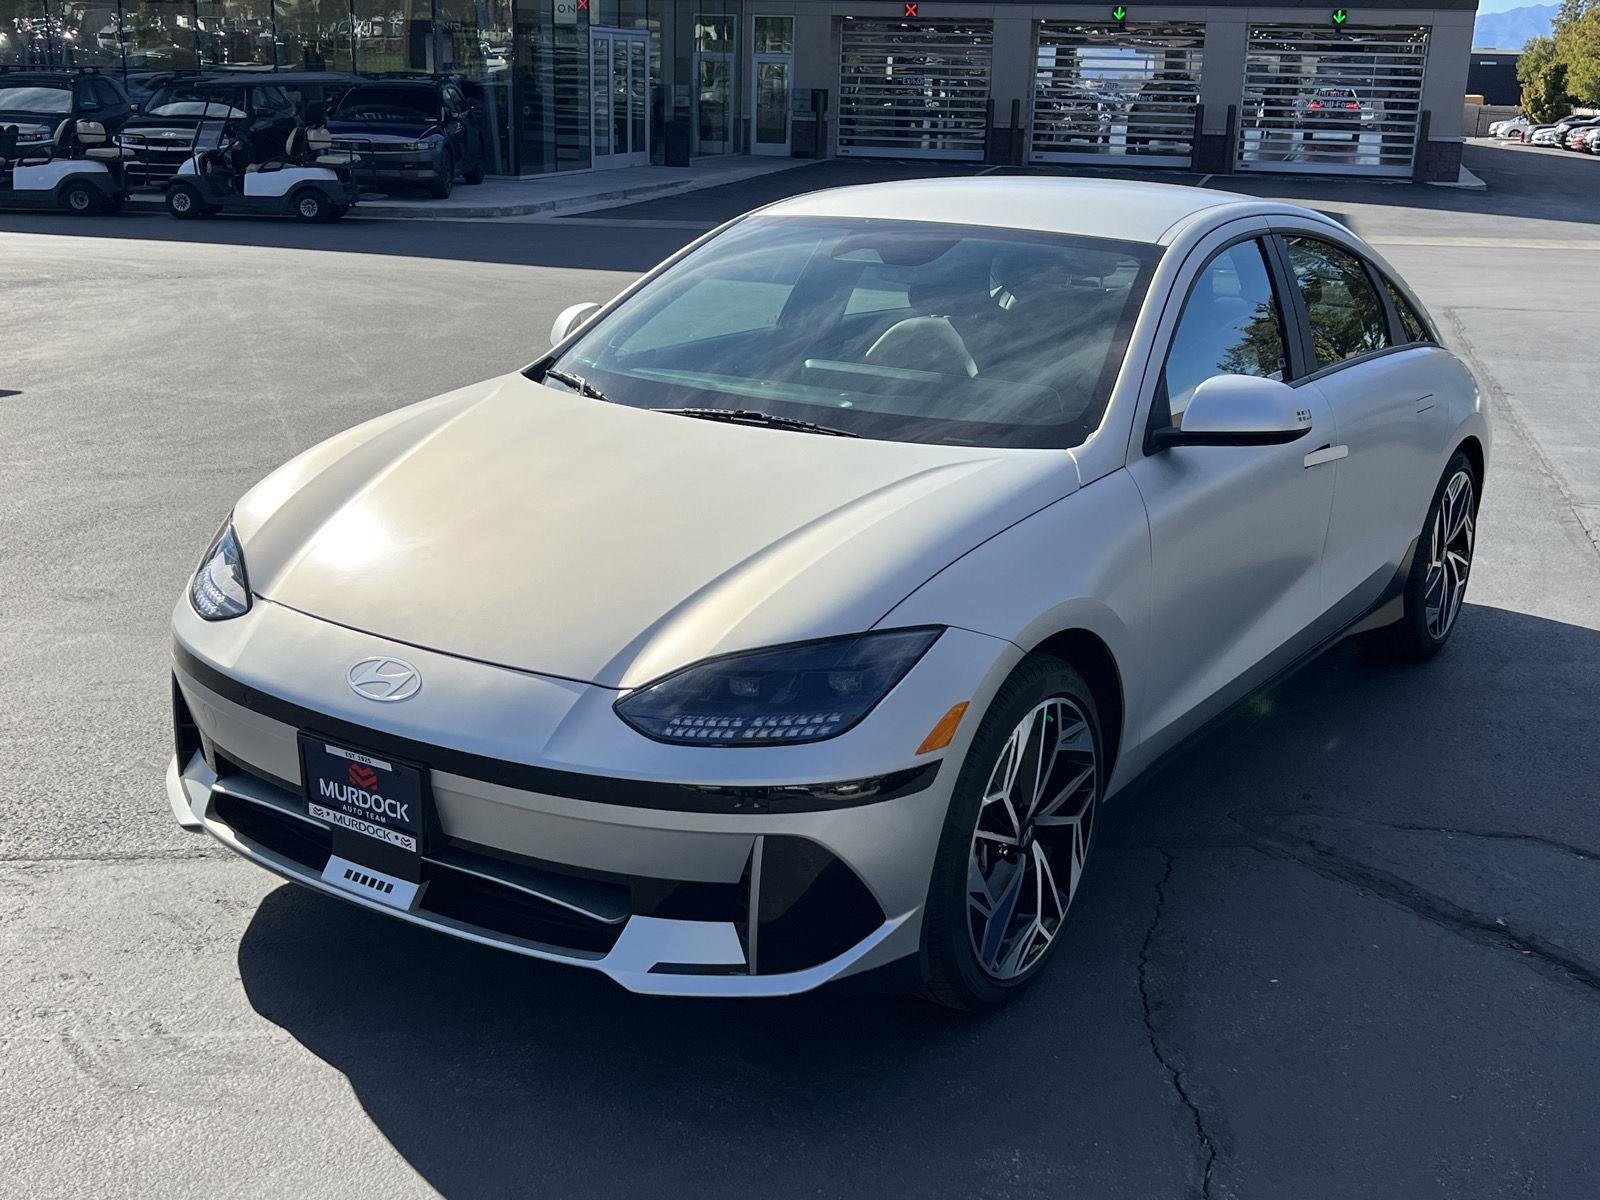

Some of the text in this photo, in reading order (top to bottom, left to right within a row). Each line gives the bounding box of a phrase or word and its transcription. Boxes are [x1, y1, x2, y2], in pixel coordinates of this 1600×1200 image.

[319, 778, 410, 822] MURDOCK
[342, 804, 387, 824] AUTO TEAM
[333, 813, 392, 841] MURDOCK
